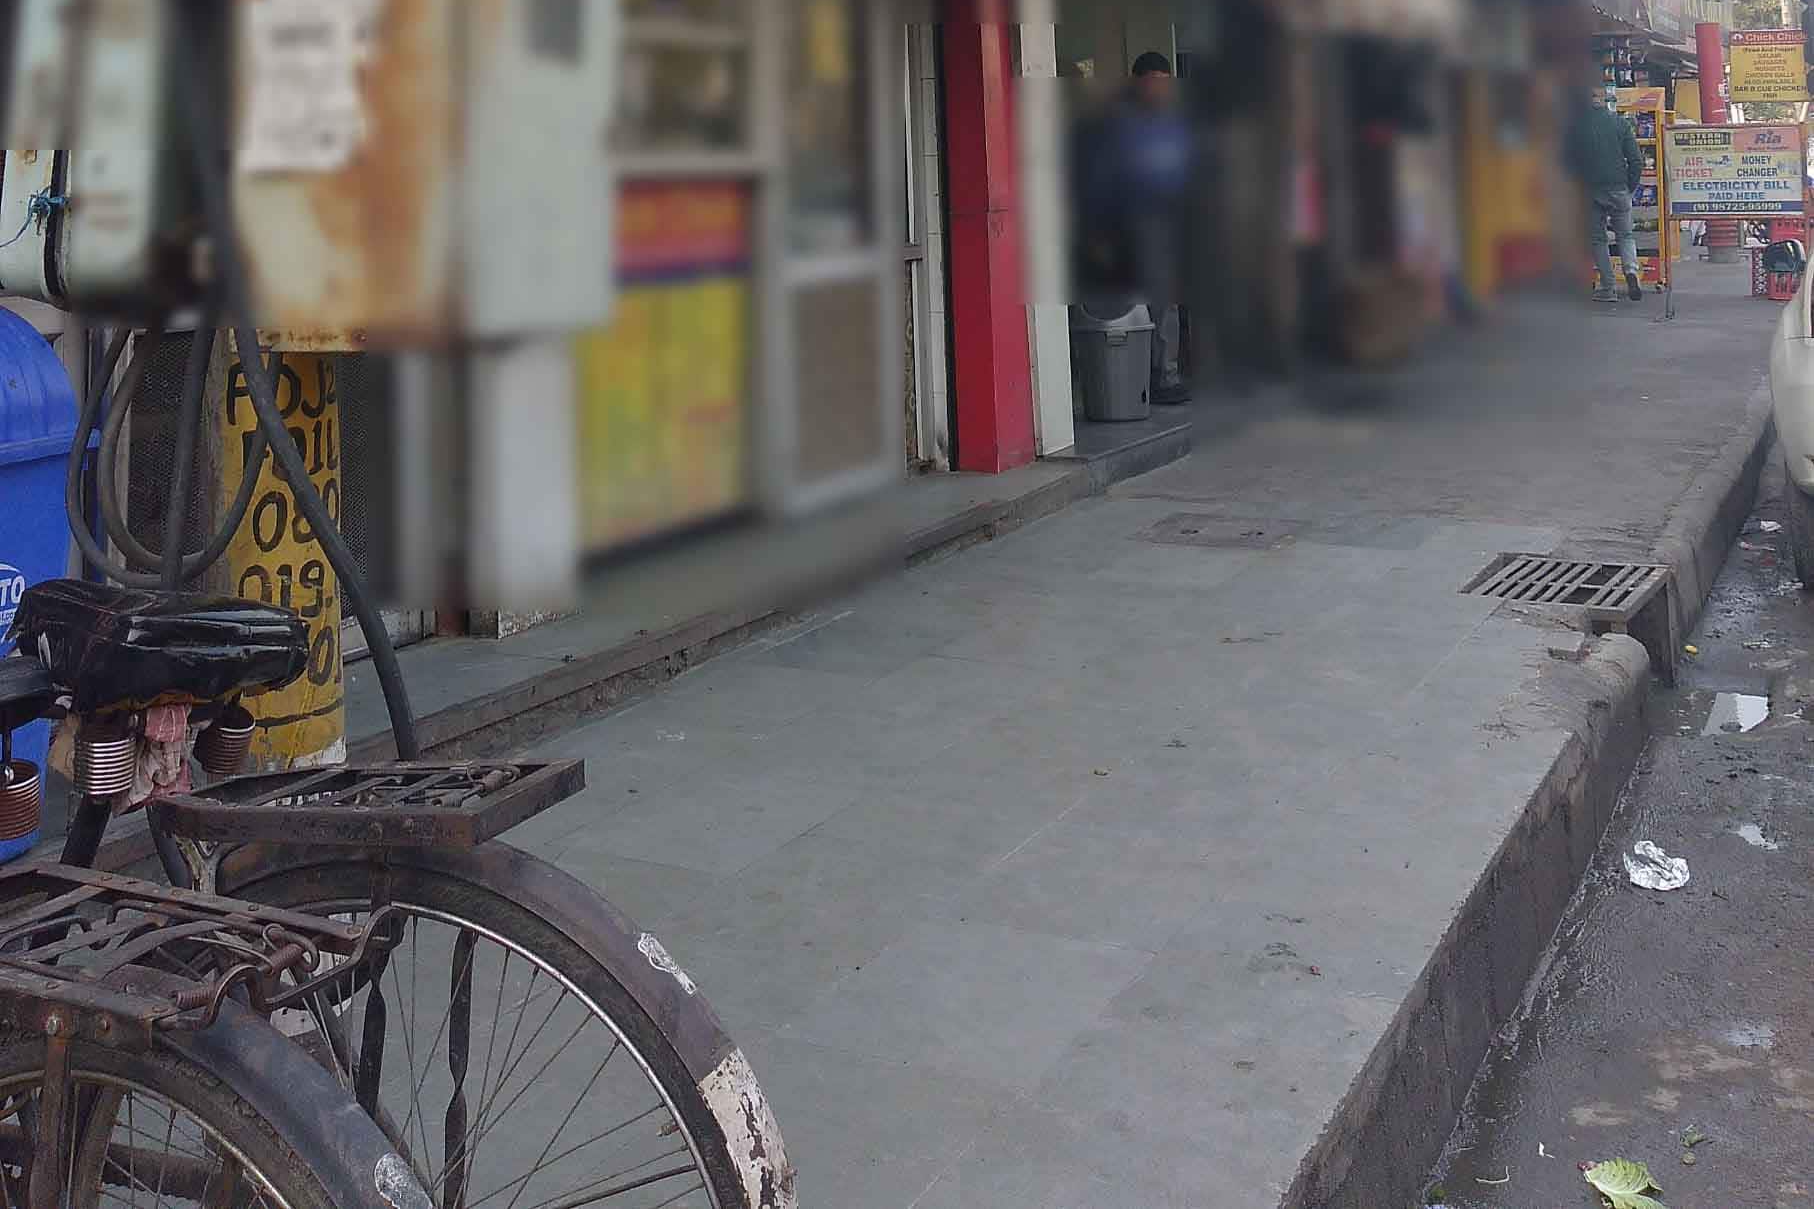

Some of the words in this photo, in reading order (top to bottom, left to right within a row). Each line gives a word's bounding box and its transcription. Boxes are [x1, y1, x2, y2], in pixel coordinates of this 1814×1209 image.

[1684, 156, 1704, 167] AIR
[1741, 155, 1772, 165] MONEY
[1673, 167, 1713, 178] TICKET
[1736, 167, 1778, 178] CHANGER
[1682, 180, 1760, 191] ELECTRICITY
[1763, 180, 1791, 190] BILL
[1707, 192, 1733, 200] PAID
[1736, 191, 1766, 200] HERE
[0, 575, 26, 607] TO
